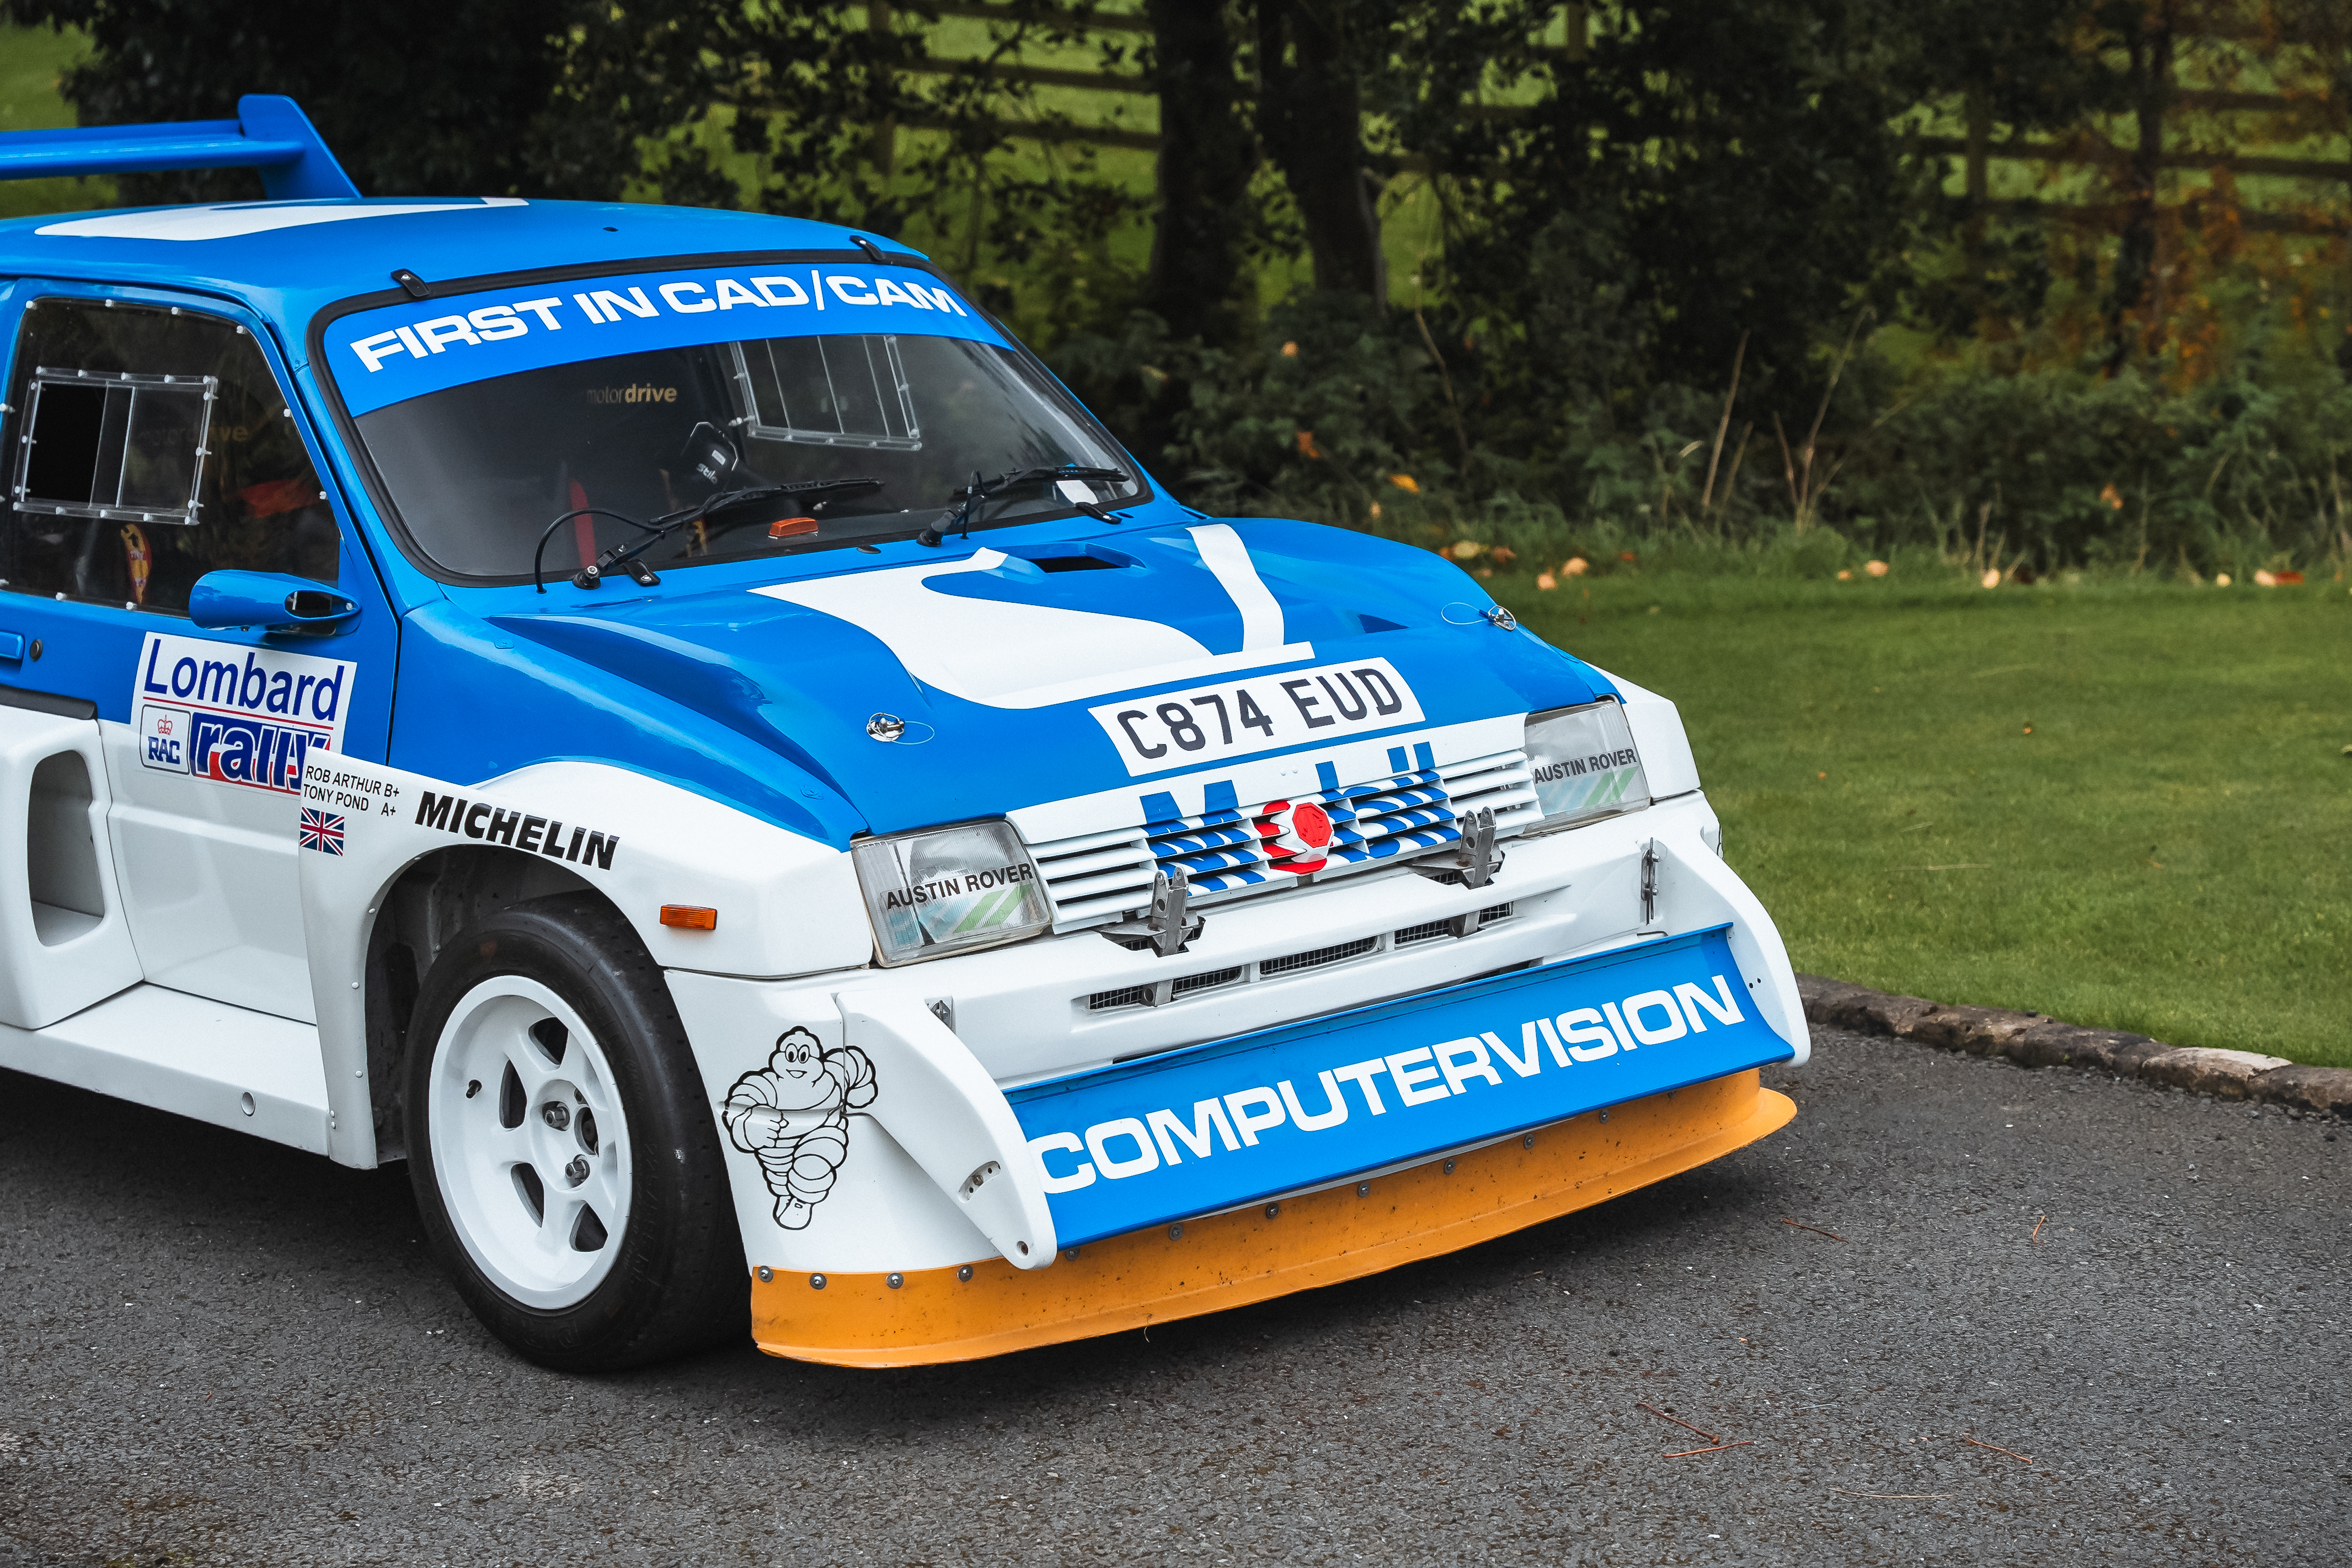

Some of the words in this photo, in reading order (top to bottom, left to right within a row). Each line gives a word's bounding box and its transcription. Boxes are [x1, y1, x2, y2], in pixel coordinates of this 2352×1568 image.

[349, 297, 564, 372] FIRST
[572, 286, 660, 324] IN
[660, 270, 968, 318] CAD/CAM
[144, 639, 345, 721] Lombard
[1117, 688, 1274, 759] C874
[1279, 667, 1403, 731] EUD
[148, 736, 180, 764] RAC
[305, 766, 331, 783] ROB
[332, 772, 382, 795] ARTHUR
[384, 783, 399, 797] B+
[1535, 758, 1587, 784] AUSTIN
[1589, 748, 1637, 772] ROVER
[303, 784, 334, 802] TONY
[335, 792, 368, 811] POND
[381, 802, 396, 816] A+
[414, 791, 620, 871] MICHELIN
[887, 878, 960, 910] AUSTIN
[965, 863, 1034, 892] ROVER
[1027, 975, 1745, 1195] COMPUTERVISION
